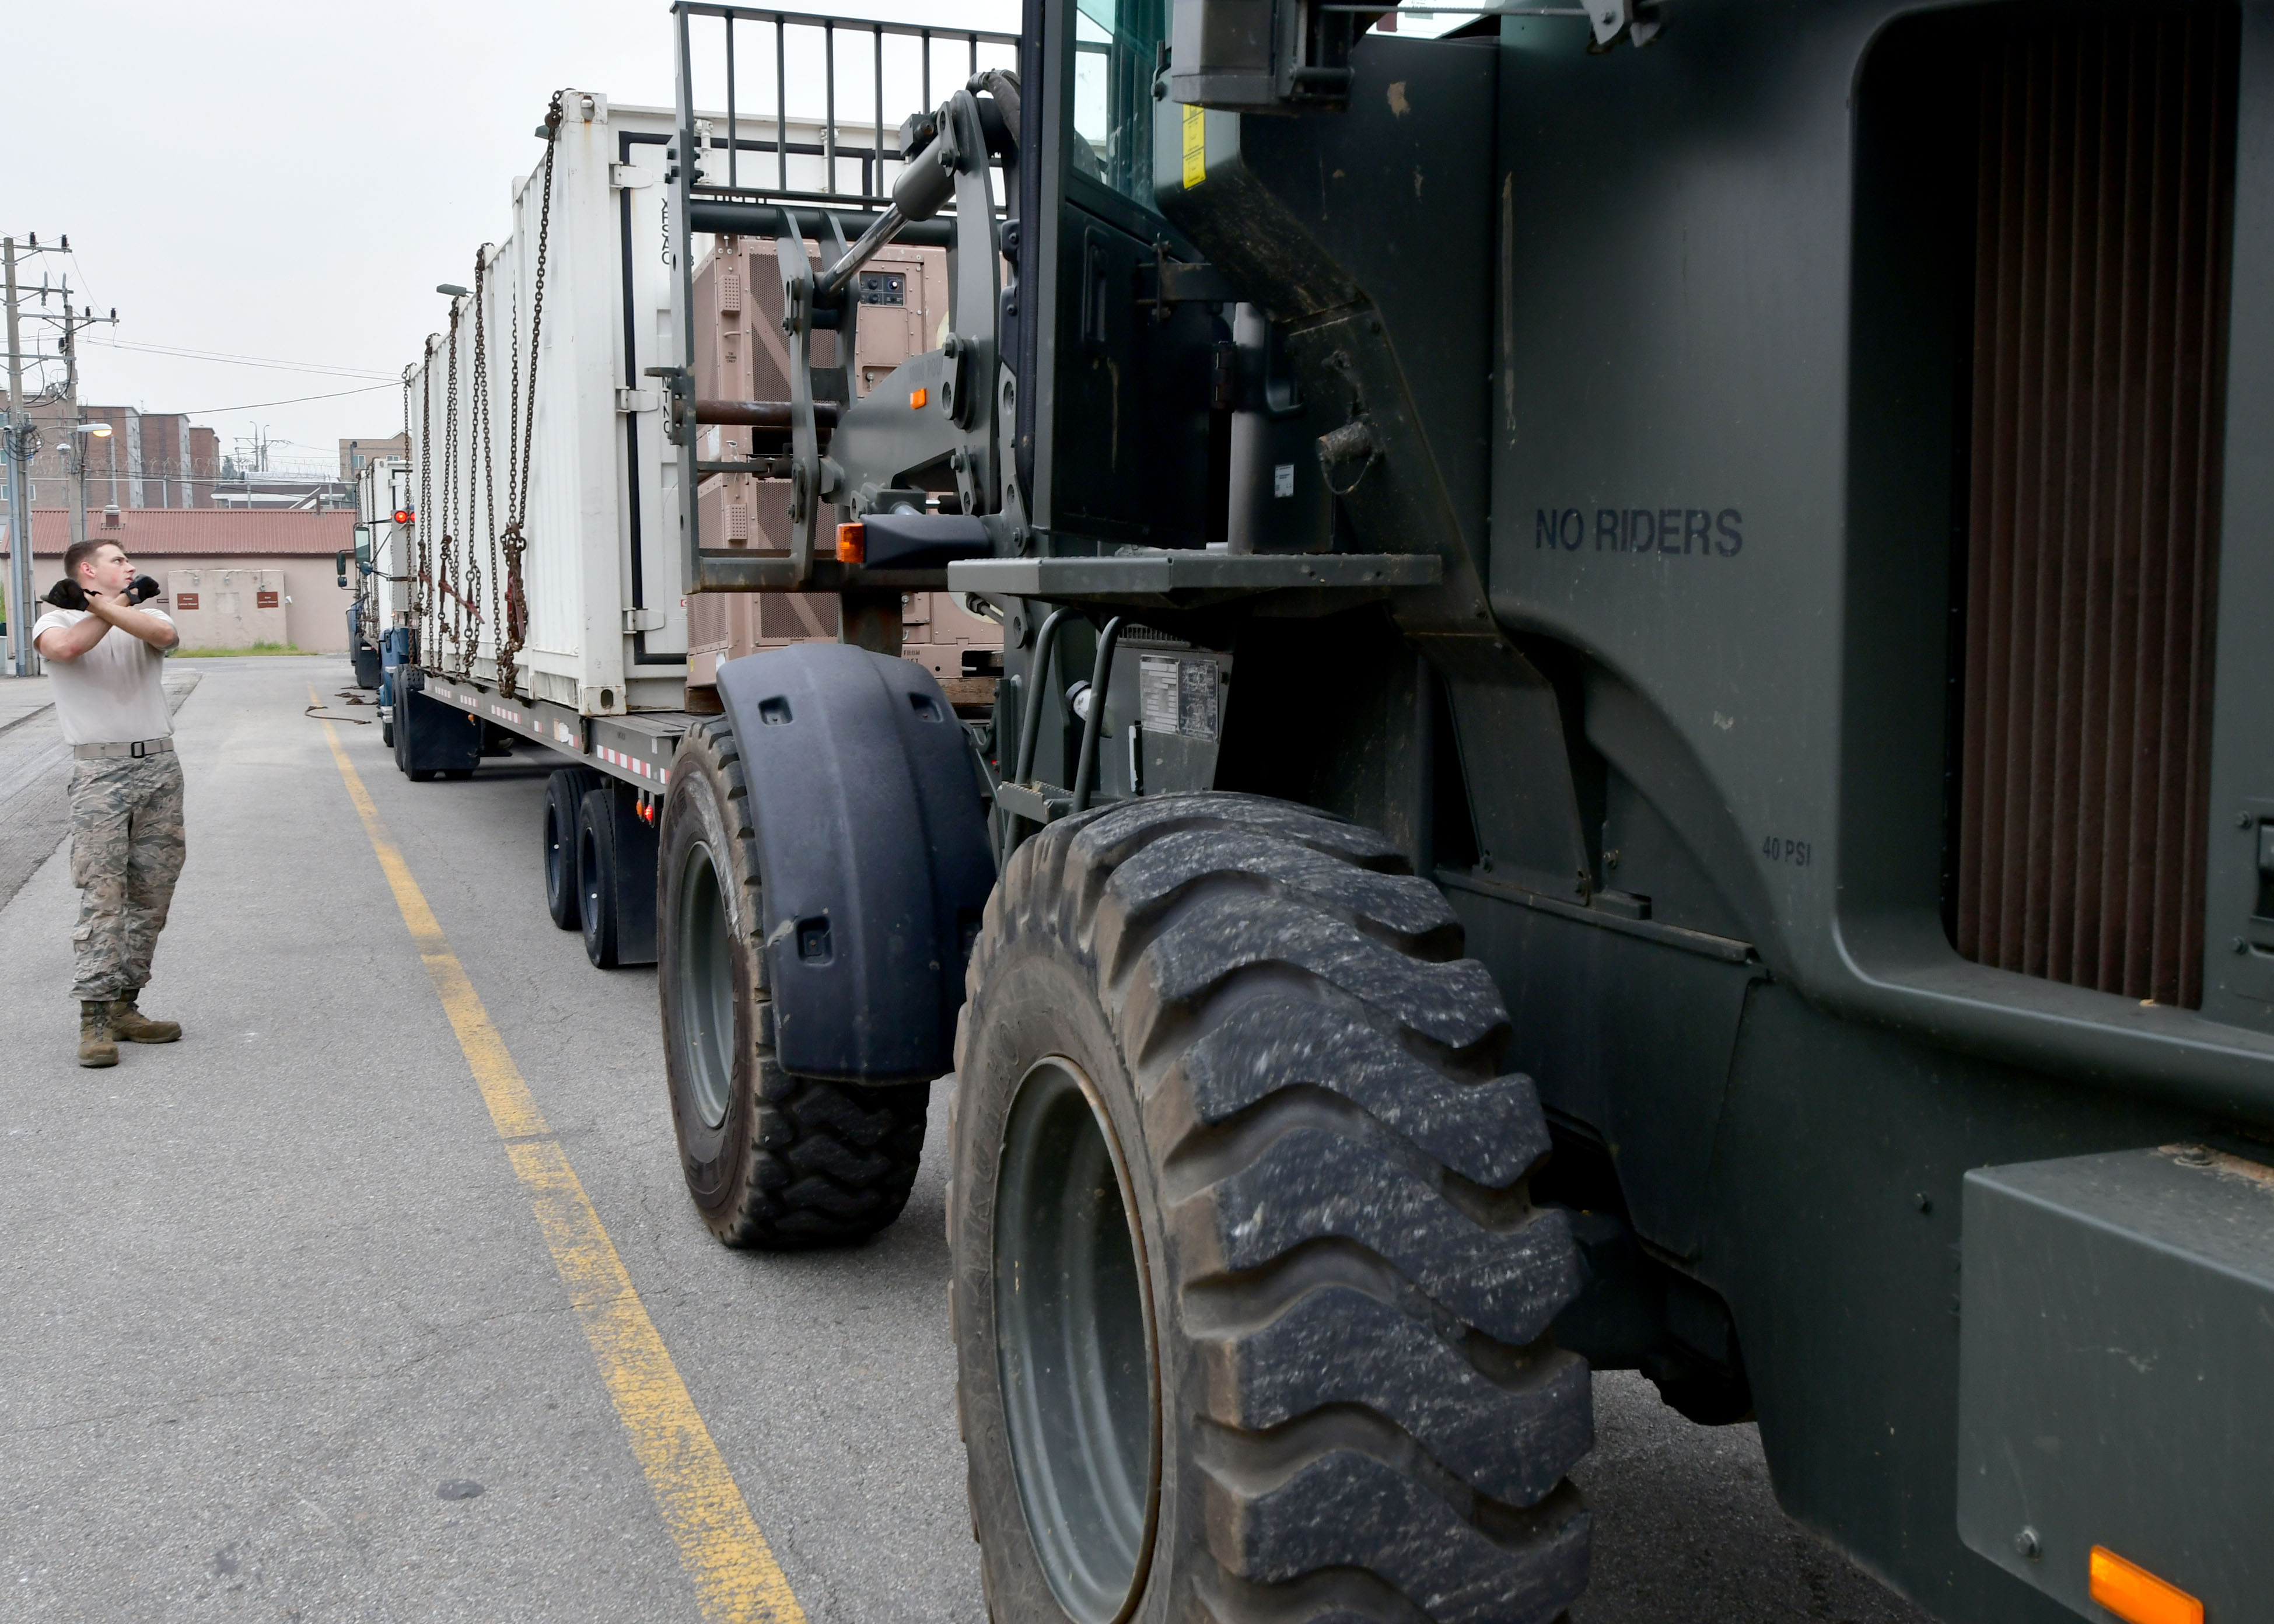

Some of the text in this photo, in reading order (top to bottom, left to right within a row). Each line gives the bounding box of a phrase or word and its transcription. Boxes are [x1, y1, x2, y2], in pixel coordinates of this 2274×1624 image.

[1536, 508, 1743, 557] NO RIDERS
[1763, 836, 1811, 867] 40 PSI
